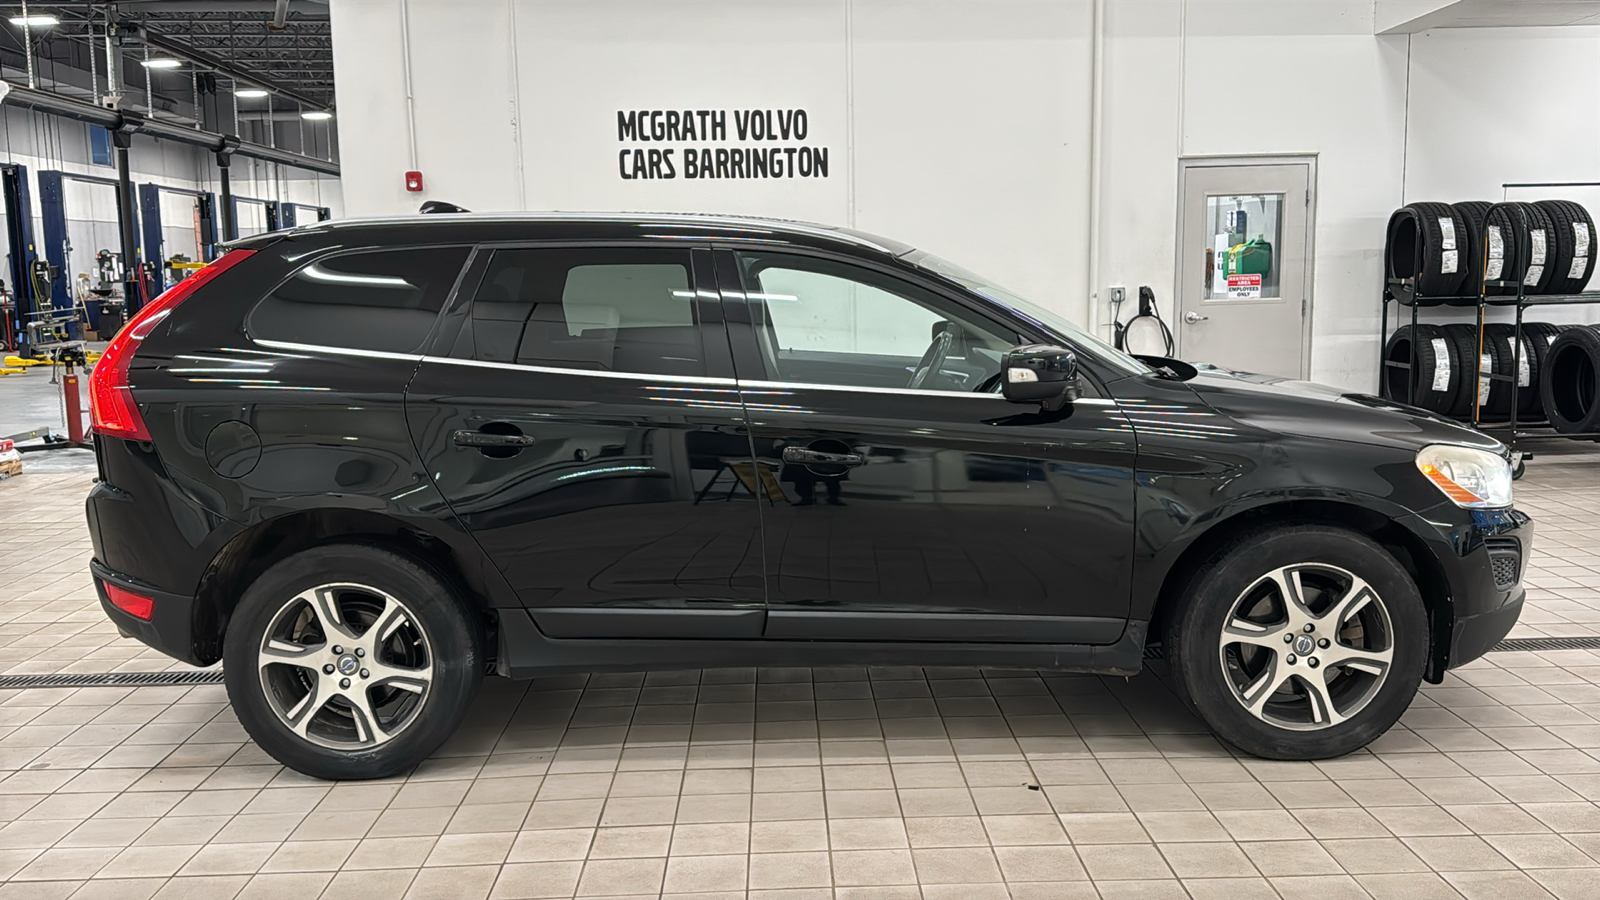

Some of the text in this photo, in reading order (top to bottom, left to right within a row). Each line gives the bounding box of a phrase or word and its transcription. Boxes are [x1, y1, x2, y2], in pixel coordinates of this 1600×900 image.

[617, 109, 808, 141] MCGRATH VOLVO
[619, 146, 828, 179] CARS BARRINGTON
